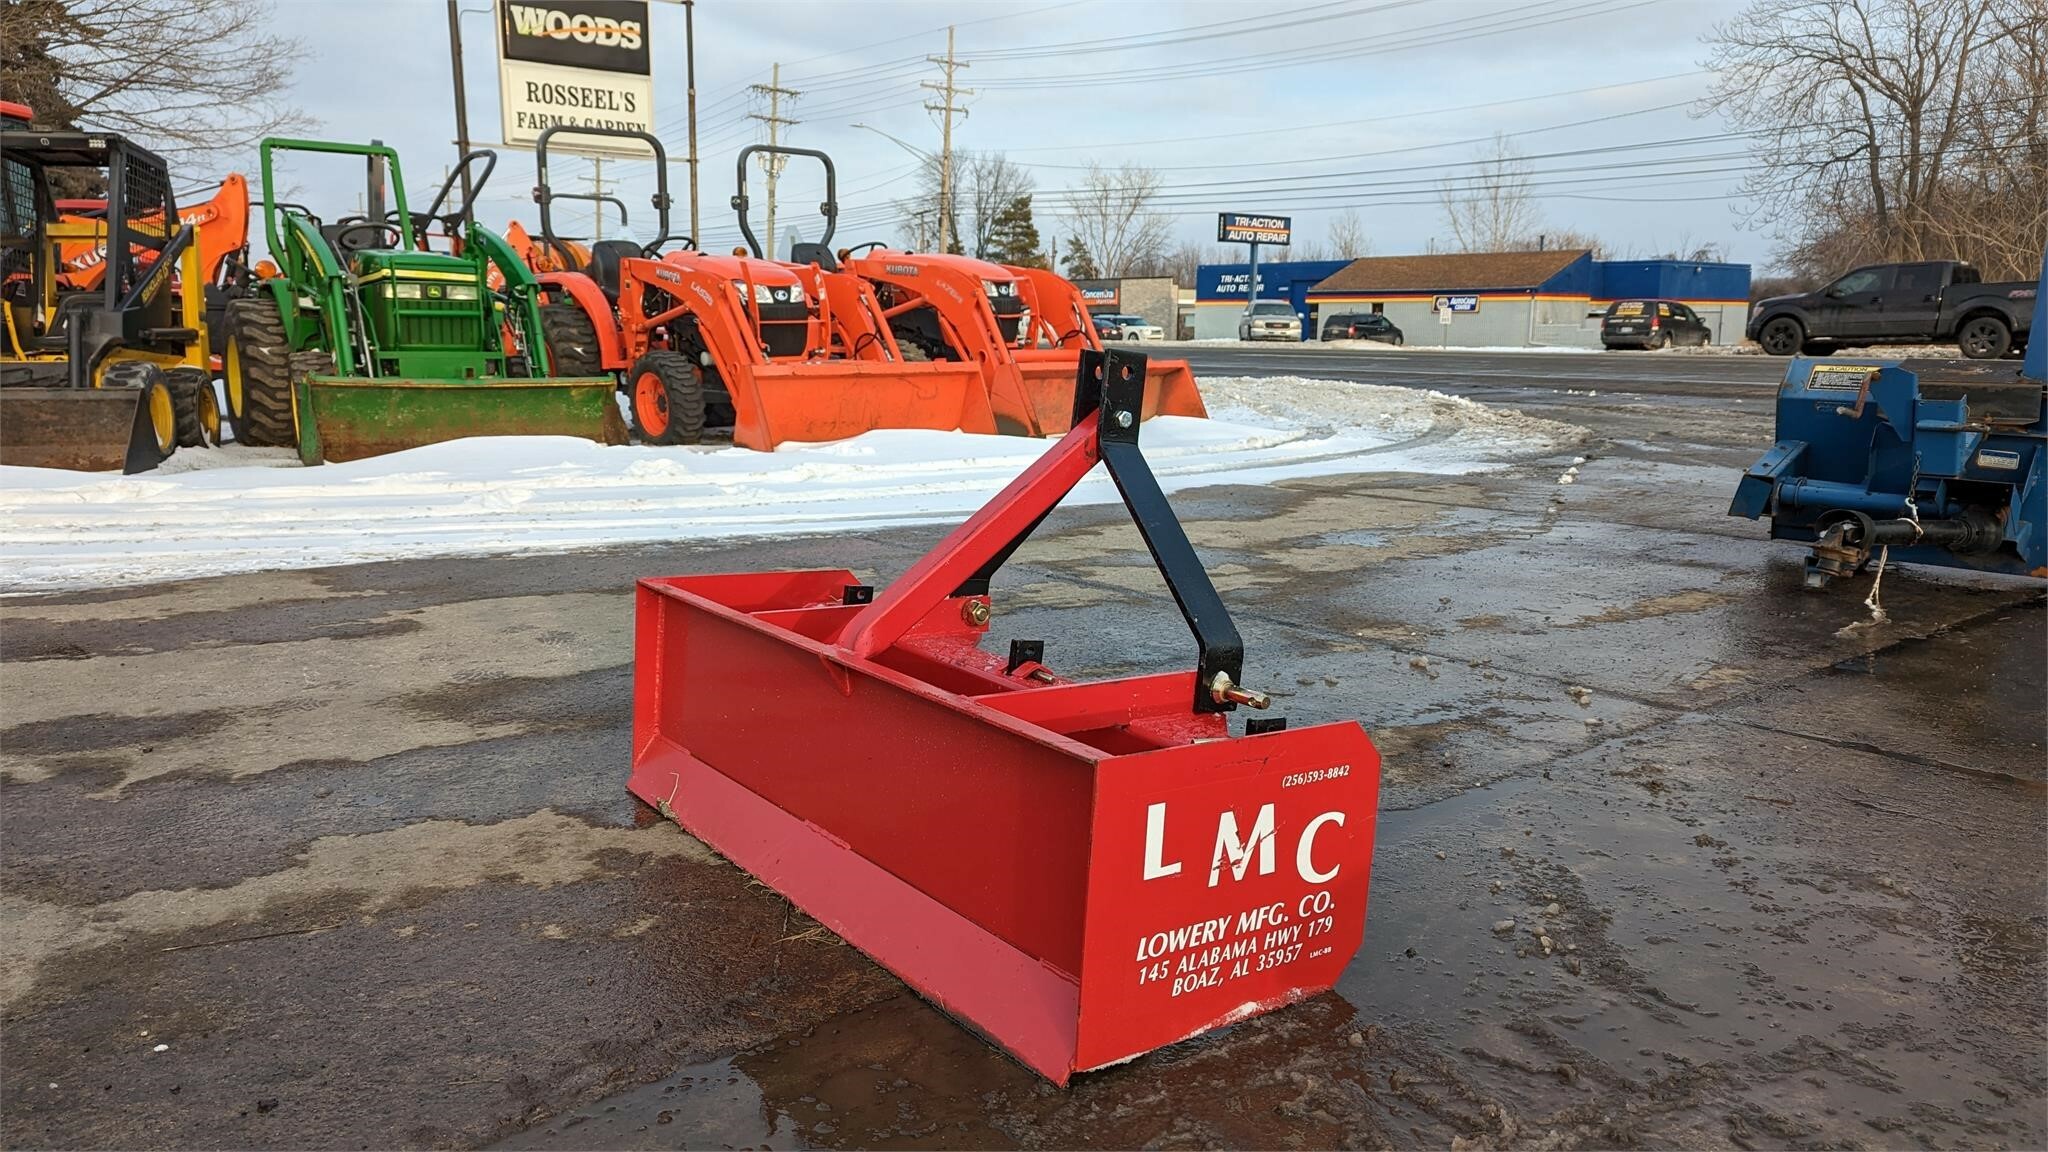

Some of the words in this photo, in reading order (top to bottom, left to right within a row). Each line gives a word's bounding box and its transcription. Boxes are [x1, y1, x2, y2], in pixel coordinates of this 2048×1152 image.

[510, 5, 642, 50] WOODS
[526, 81, 636, 113] ROSSEEL'S
[516, 111, 564, 130] FARM
[1234, 216, 1285, 229] TRI-ACTION
[1228, 231, 1254, 241] AUTO
[1256, 232, 1287, 243] REPAIR
[656, 268, 681, 285] KUBOTA
[886, 264, 919, 276] KUBOTA
[1221, 274, 1262, 283] TRI-ACTN
[1216, 283, 1237, 293] AUTO
[1281, 765, 1350, 788] (256)593-8842
[1136, 915, 1232, 962] LOWERY
[1235, 902, 1289, 935] MFG.
[1298, 890, 1335, 918] CO.
[1140, 959, 1170, 985] 145
[1175, 936, 1257, 975] ALABAMA
[1263, 923, 1303, 951] HWY
[1308, 915, 1333, 938] 179
[1171, 966, 1224, 997] BOAZ,
[1229, 958, 1249, 980] AL
[1256, 943, 1303, 972] 35957
